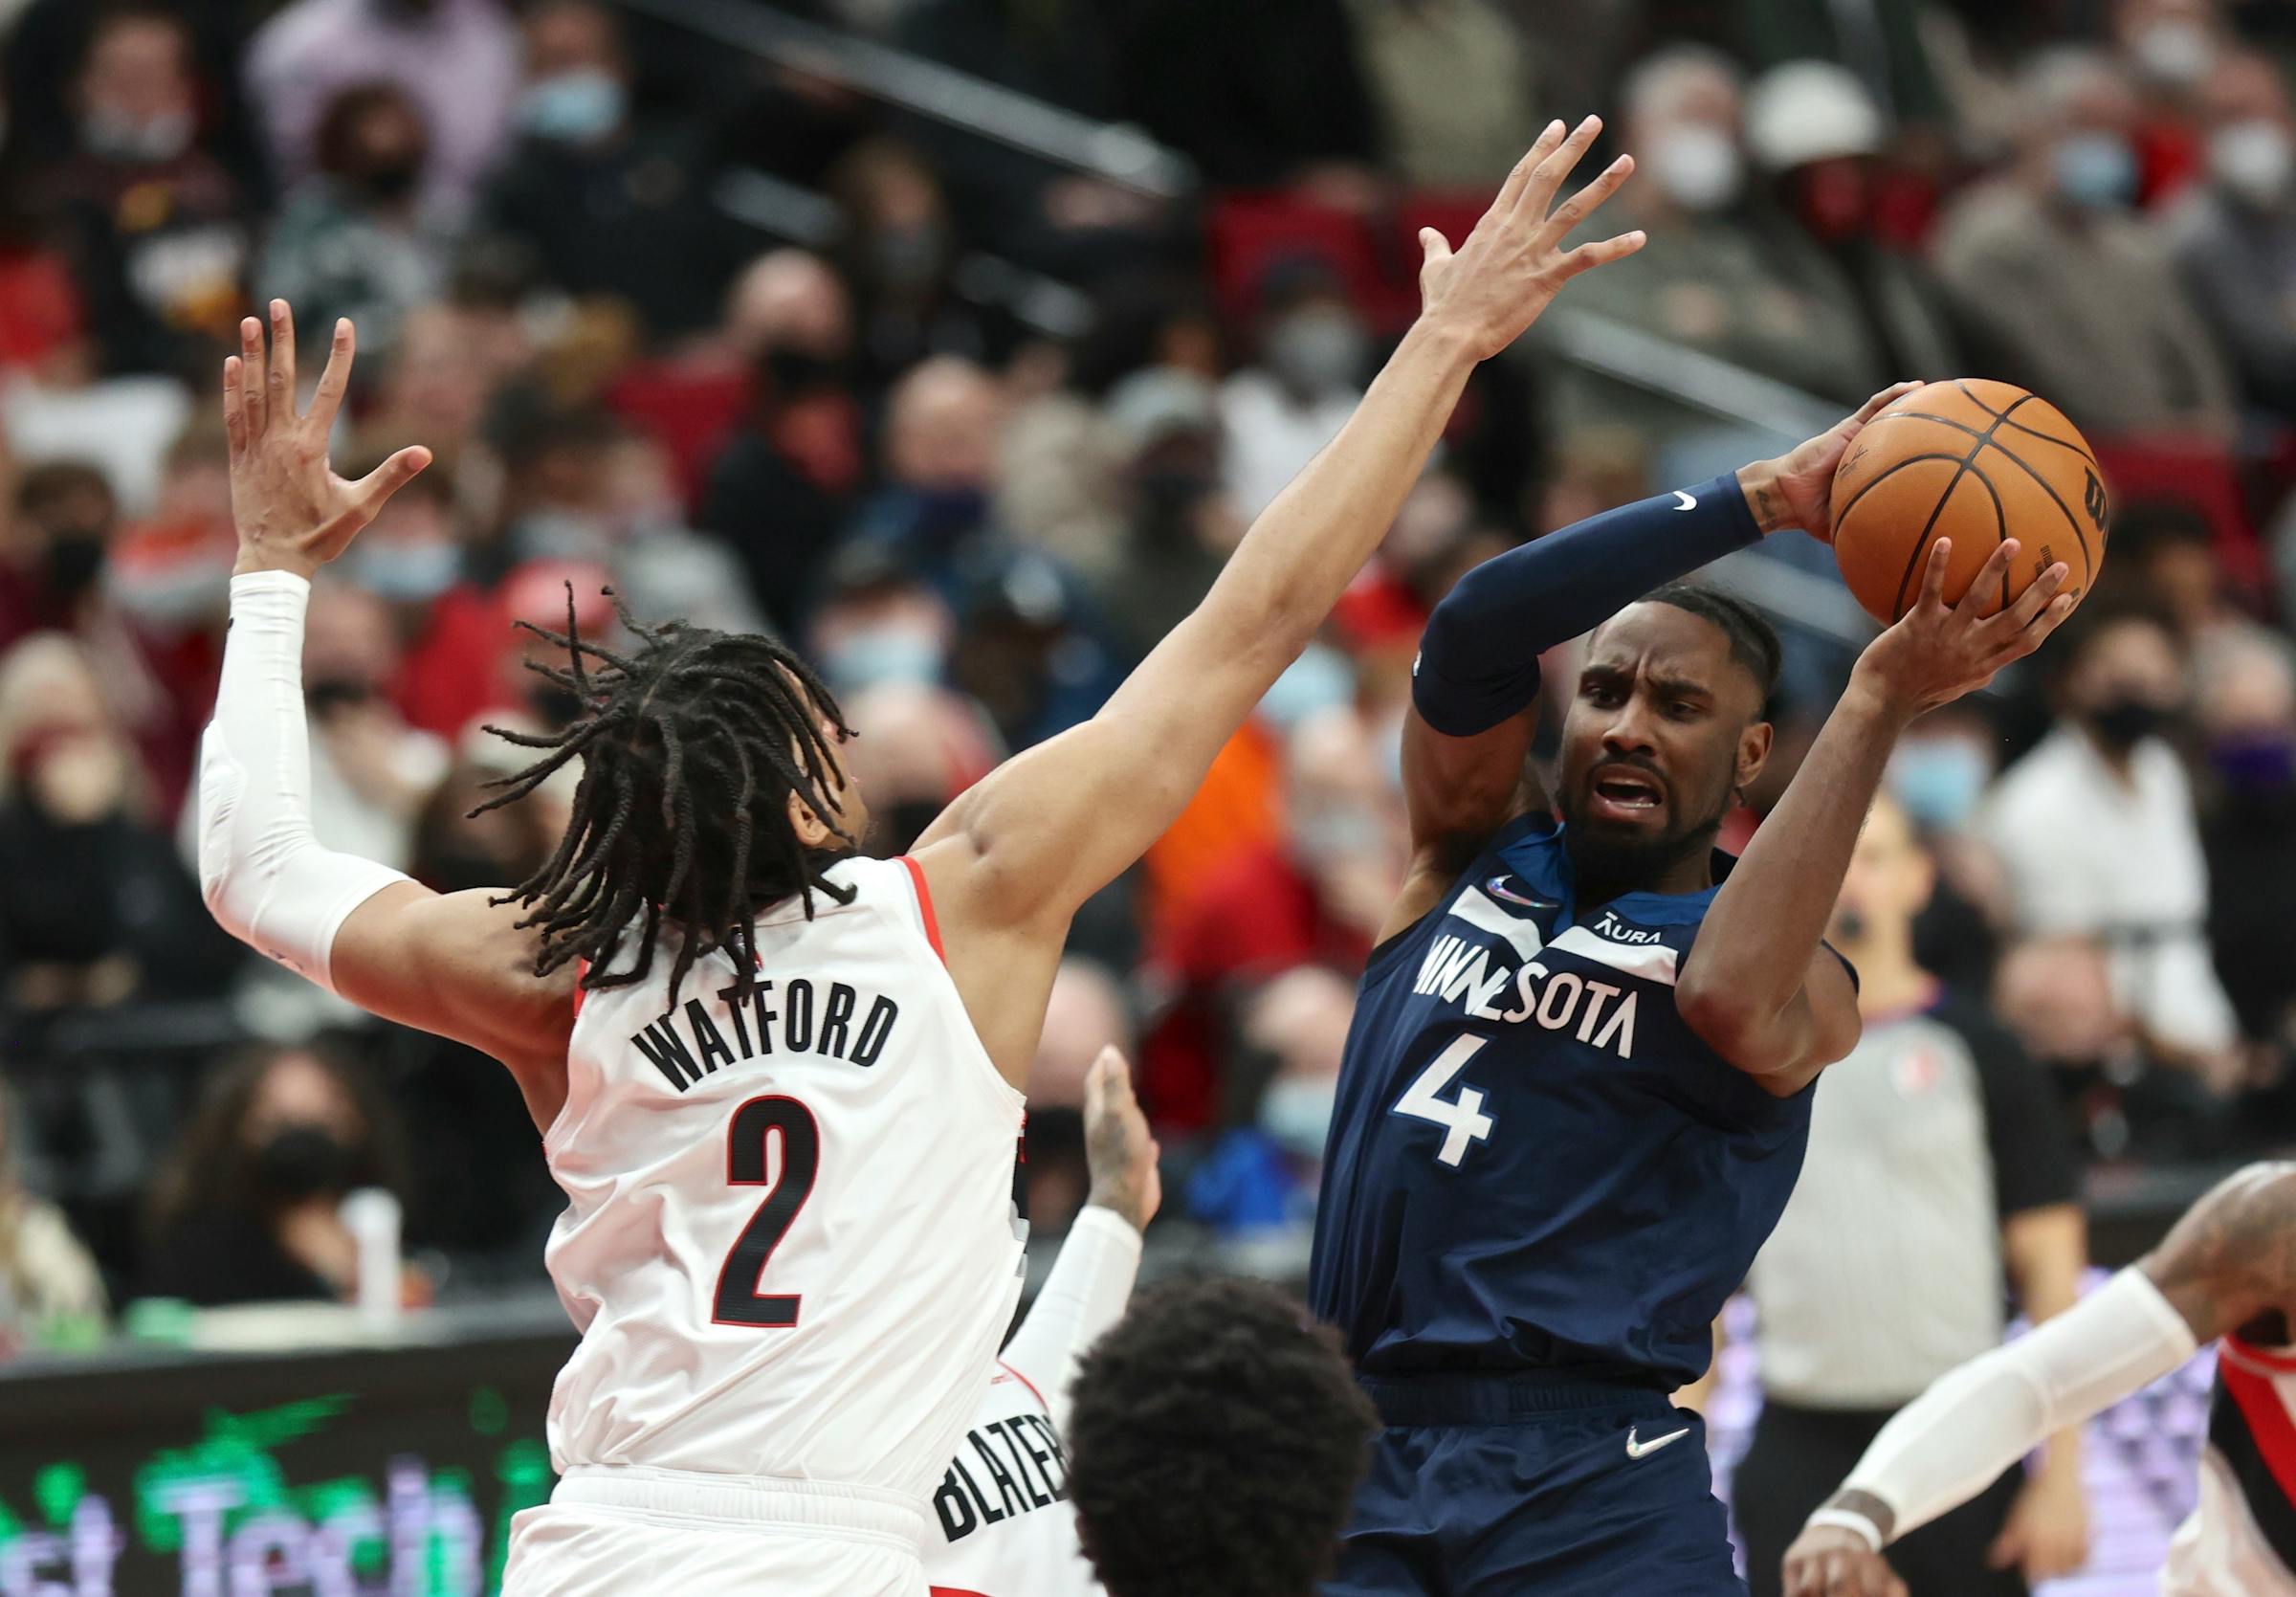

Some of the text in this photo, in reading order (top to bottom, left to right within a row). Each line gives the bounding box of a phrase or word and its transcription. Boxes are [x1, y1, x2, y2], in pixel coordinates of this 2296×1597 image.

[629, 978, 899, 1093] WATFORD
[1391, 1031, 1495, 1169] 4
[711, 1094, 821, 1329] 2
[933, 1413, 1071, 1543] BLAZER
